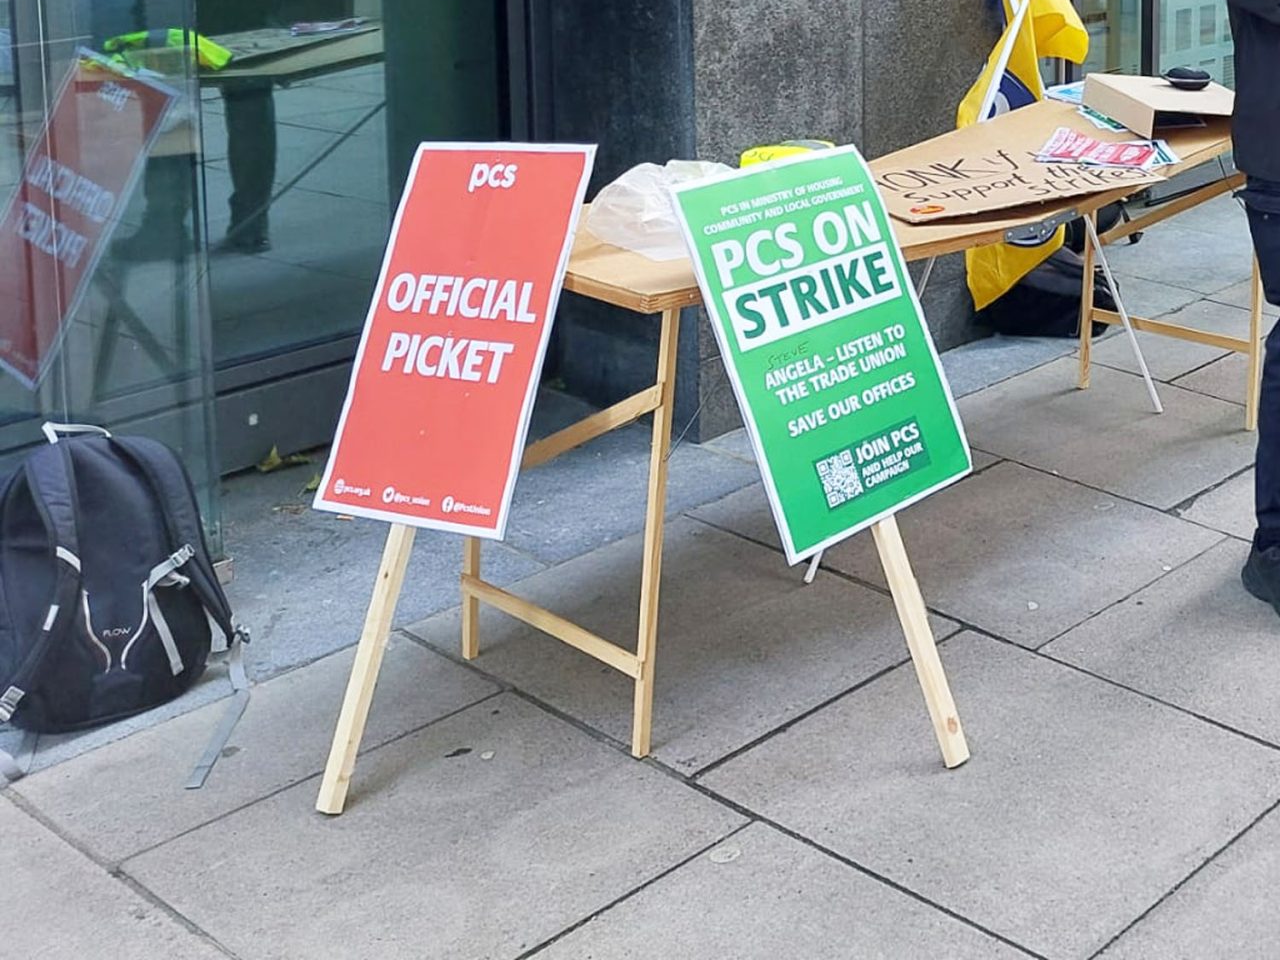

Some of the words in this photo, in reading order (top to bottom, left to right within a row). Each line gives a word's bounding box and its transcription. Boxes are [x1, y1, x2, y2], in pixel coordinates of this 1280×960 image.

[468, 162, 518, 192] pcs
[711, 222, 805, 288] PCS
[812, 200, 882, 256] ON
[386, 272, 537, 324] OFFICIAL
[735, 250, 895, 340] STRIKE
[381, 332, 515, 384] PICKET
[765, 354, 825, 390] ANGELA
[835, 332, 884, 362] LISTEN
[883, 324, 905, 341] TO
[775, 383, 810, 406] THE
[809, 364, 859, 393] TRADE
[858, 342, 907, 374] UNION
[787, 408, 828, 438] SAVE
[827, 394, 862, 420] OUR
[861, 371, 916, 406] OFFICES
[855, 434, 891, 465] JOIN
[890, 421, 920, 448] PCS
[861, 461, 882, 478] AND
[880, 451, 904, 469] HELP
[904, 442, 924, 458] OUR
[865, 460, 910, 488] CAMPAIGN
